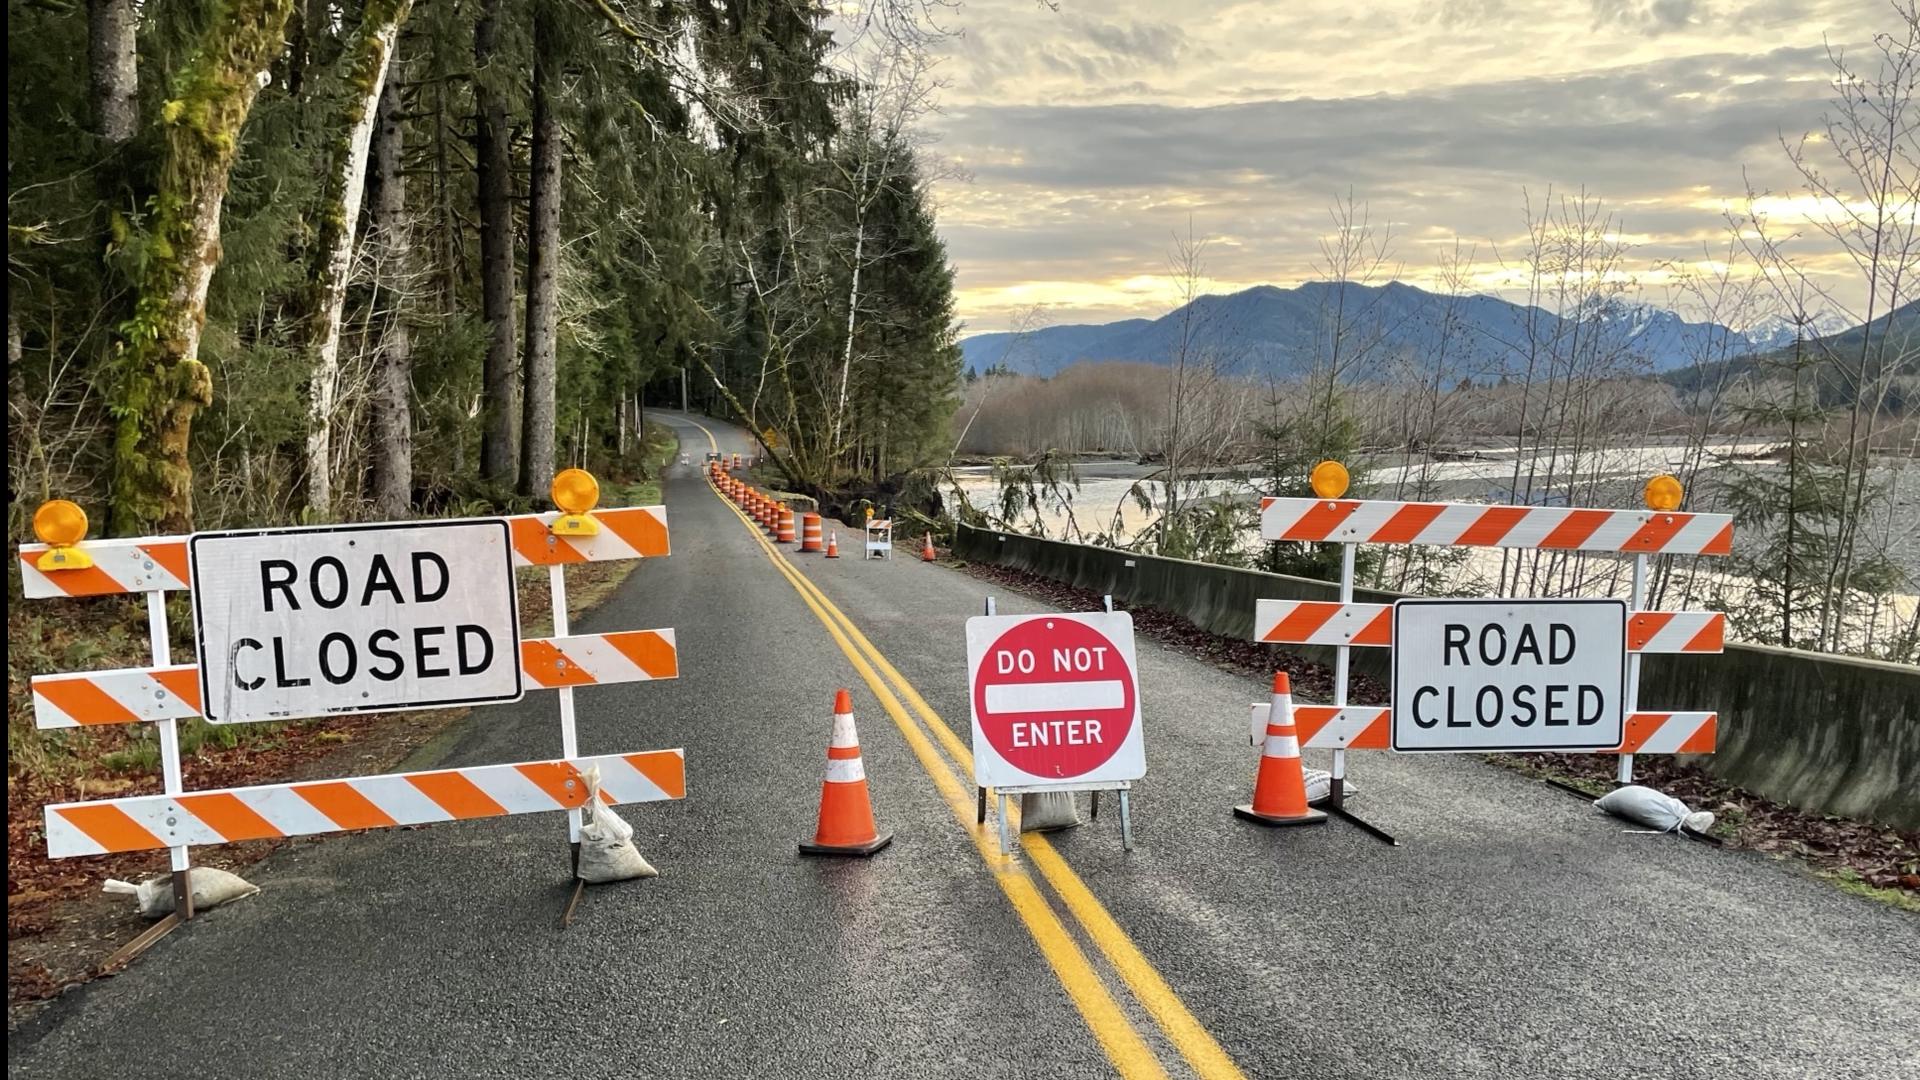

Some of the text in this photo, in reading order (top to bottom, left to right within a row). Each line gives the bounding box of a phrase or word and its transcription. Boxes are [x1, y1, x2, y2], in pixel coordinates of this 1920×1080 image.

[260, 551, 450, 612] ROAD
[232, 624, 494, 691] CLOSED
[997, 647, 1107, 674] DO NOT
[1443, 622, 1576, 667] ROAD
[1412, 684, 1604, 729] CLOSED
[1012, 719, 1103, 748] ENTER
